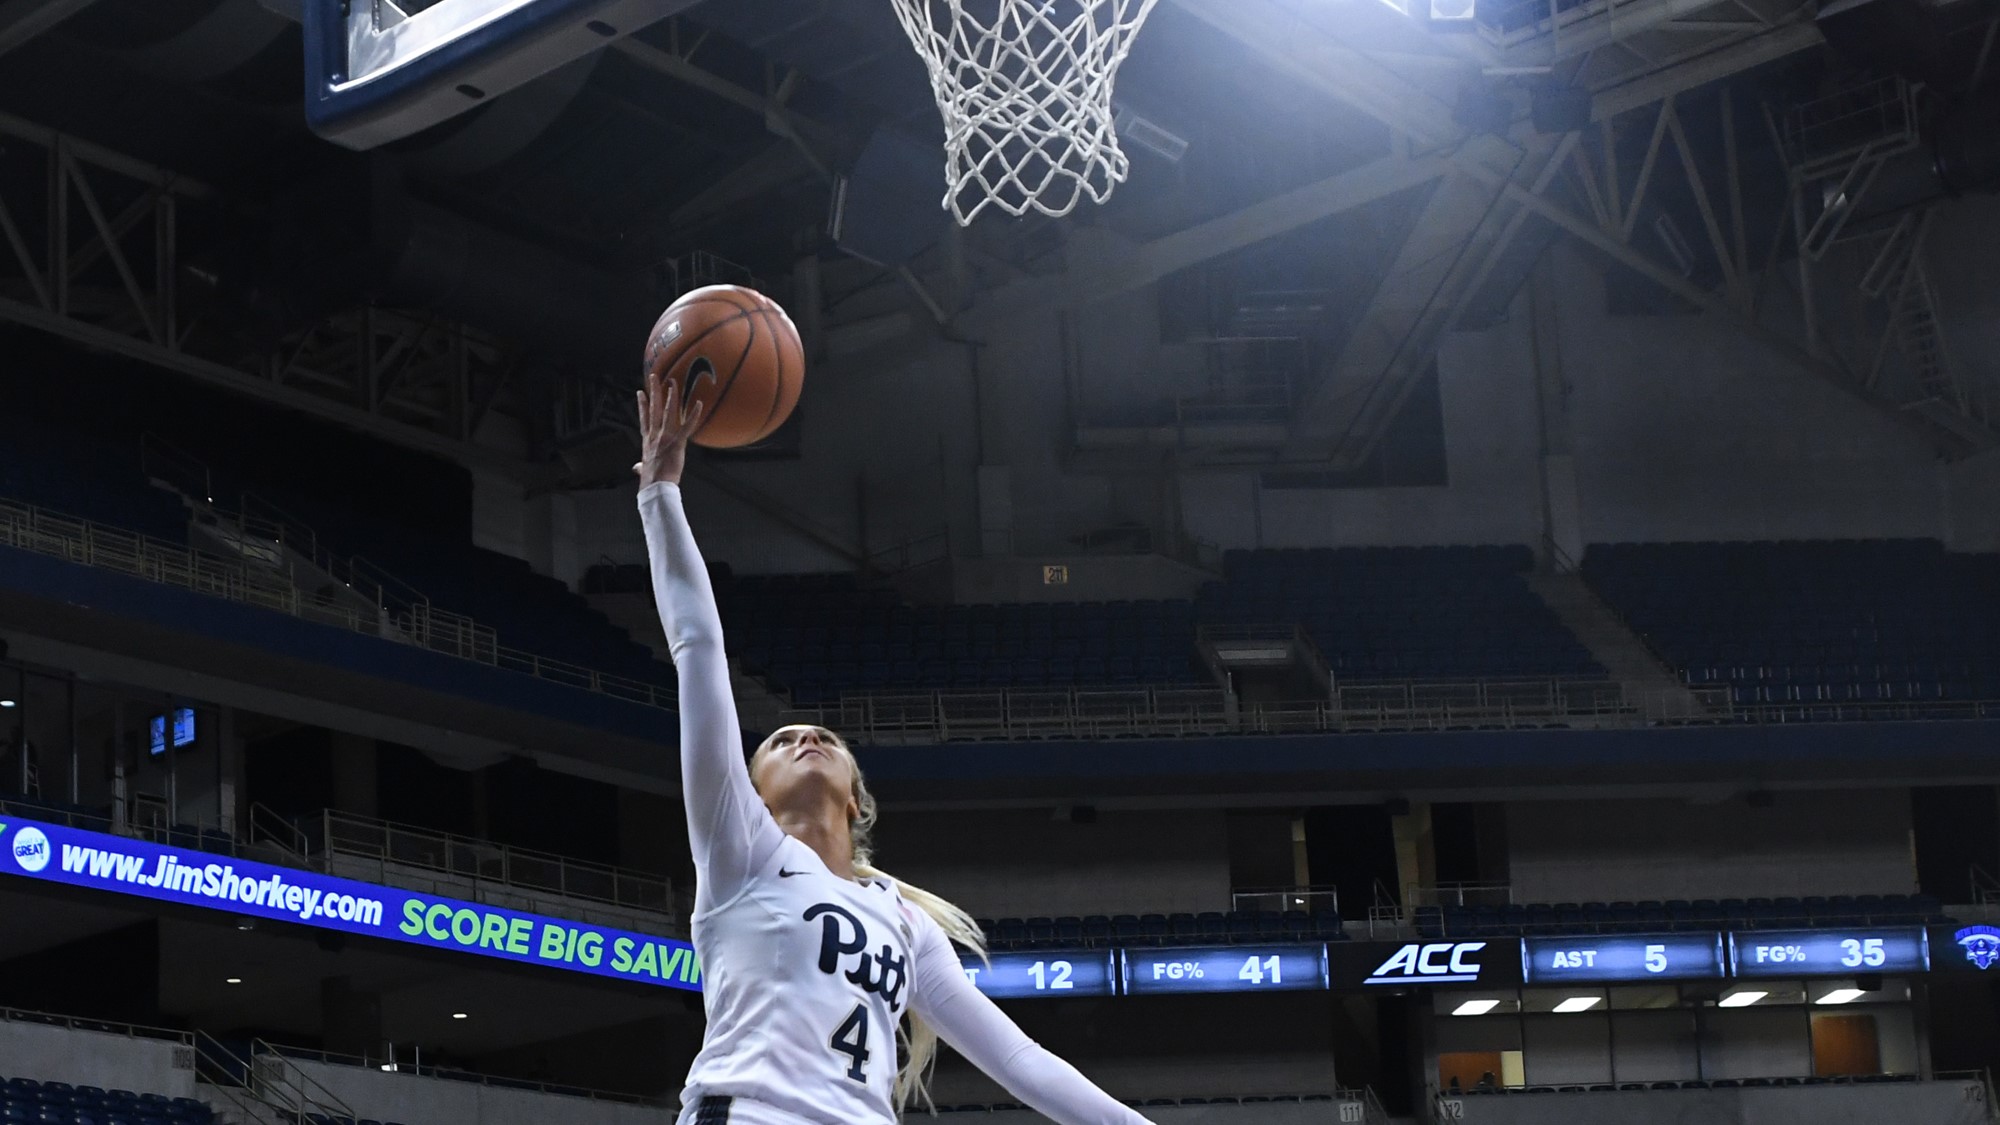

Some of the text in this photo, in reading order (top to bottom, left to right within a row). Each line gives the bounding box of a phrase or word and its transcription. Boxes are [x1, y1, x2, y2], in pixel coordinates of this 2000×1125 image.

[15, 842, 44, 857] GREAT
[61, 843, 383, 926] www.JimShorkey.com
[398, 898, 534, 955] SCORE
[538, 923, 605, 968] BIG
[802, 902, 906, 1014] Pitt
[1372, 942, 1487, 976] ACC
[1552, 944, 1668, 973] AST 5
[1755, 938, 1886, 967] FG% 35
[1027, 960, 1074, 990] 12
[1152, 954, 1282, 985] FG% 41
[829, 1001, 871, 1086] 4
[1343, 1106, 1360, 1121] 111
